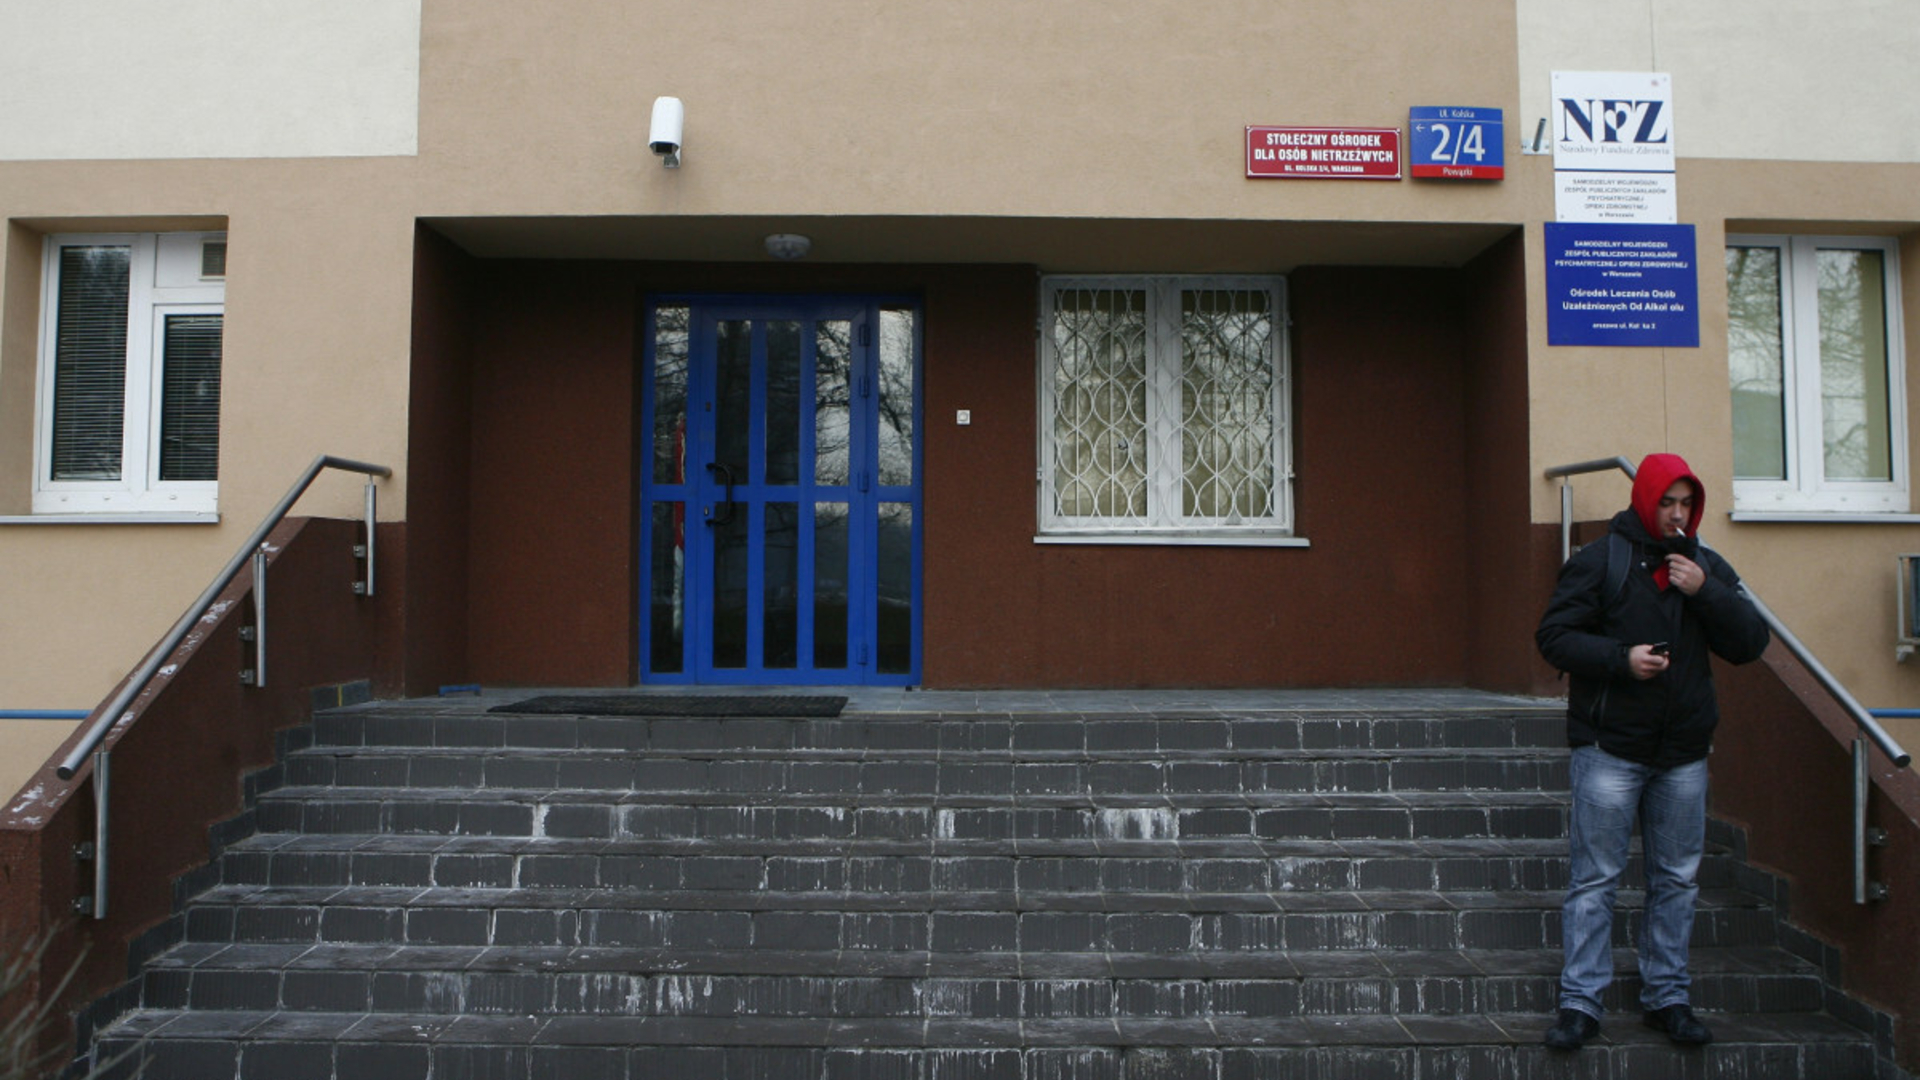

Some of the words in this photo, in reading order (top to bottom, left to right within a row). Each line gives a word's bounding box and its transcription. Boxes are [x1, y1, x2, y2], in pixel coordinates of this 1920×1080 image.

[1452, 109, 1475, 118] Kolska
[1559, 98, 1668, 143] NFZ
[1266, 133, 1327, 146] STOŁECZNY
[1331, 131, 1381, 147] OŚRODEK
[1431, 123, 1485, 165] 2/4
[1560, 144, 1598, 155] Narodowy
[1601, 145, 1633, 154] Fundusz
[1636, 146, 1670, 155] Zdrowia
[1255, 149, 1275, 160] DLA
[1278, 147, 1307, 161] OSÓB
[1311, 148, 1393, 163] NIETRZEŹWYCH
[1331, 165, 1364, 173] WARSZAWA
[1443, 167, 1473, 177] Powązki
[1574, 240, 1621, 248] SAMODZIELNY
[1622, 240, 1668, 248] WOJEWÓDZKI
[1564, 249, 1591, 258] ZESPÓŁ
[1592, 250, 1639, 258] PUBLICZNYCH
[1640, 250, 1678, 258] ZAKŁADÓW
[1554, 259, 1618, 268] PSYCHIATRYCZNEJ
[1618, 260, 1641, 268] OPIEKI
[1642, 261, 1688, 269] ZDROWOTNEJ
[1609, 270, 1642, 278] Warszawie
[1569, 288, 1608, 298] Ośrodek
[1610, 289, 1650, 298] Leczenia
[1651, 289, 1676, 298] Osób
[1562, 301, 1627, 313] Uzależnionych
[1629, 302, 1643, 311] Od
